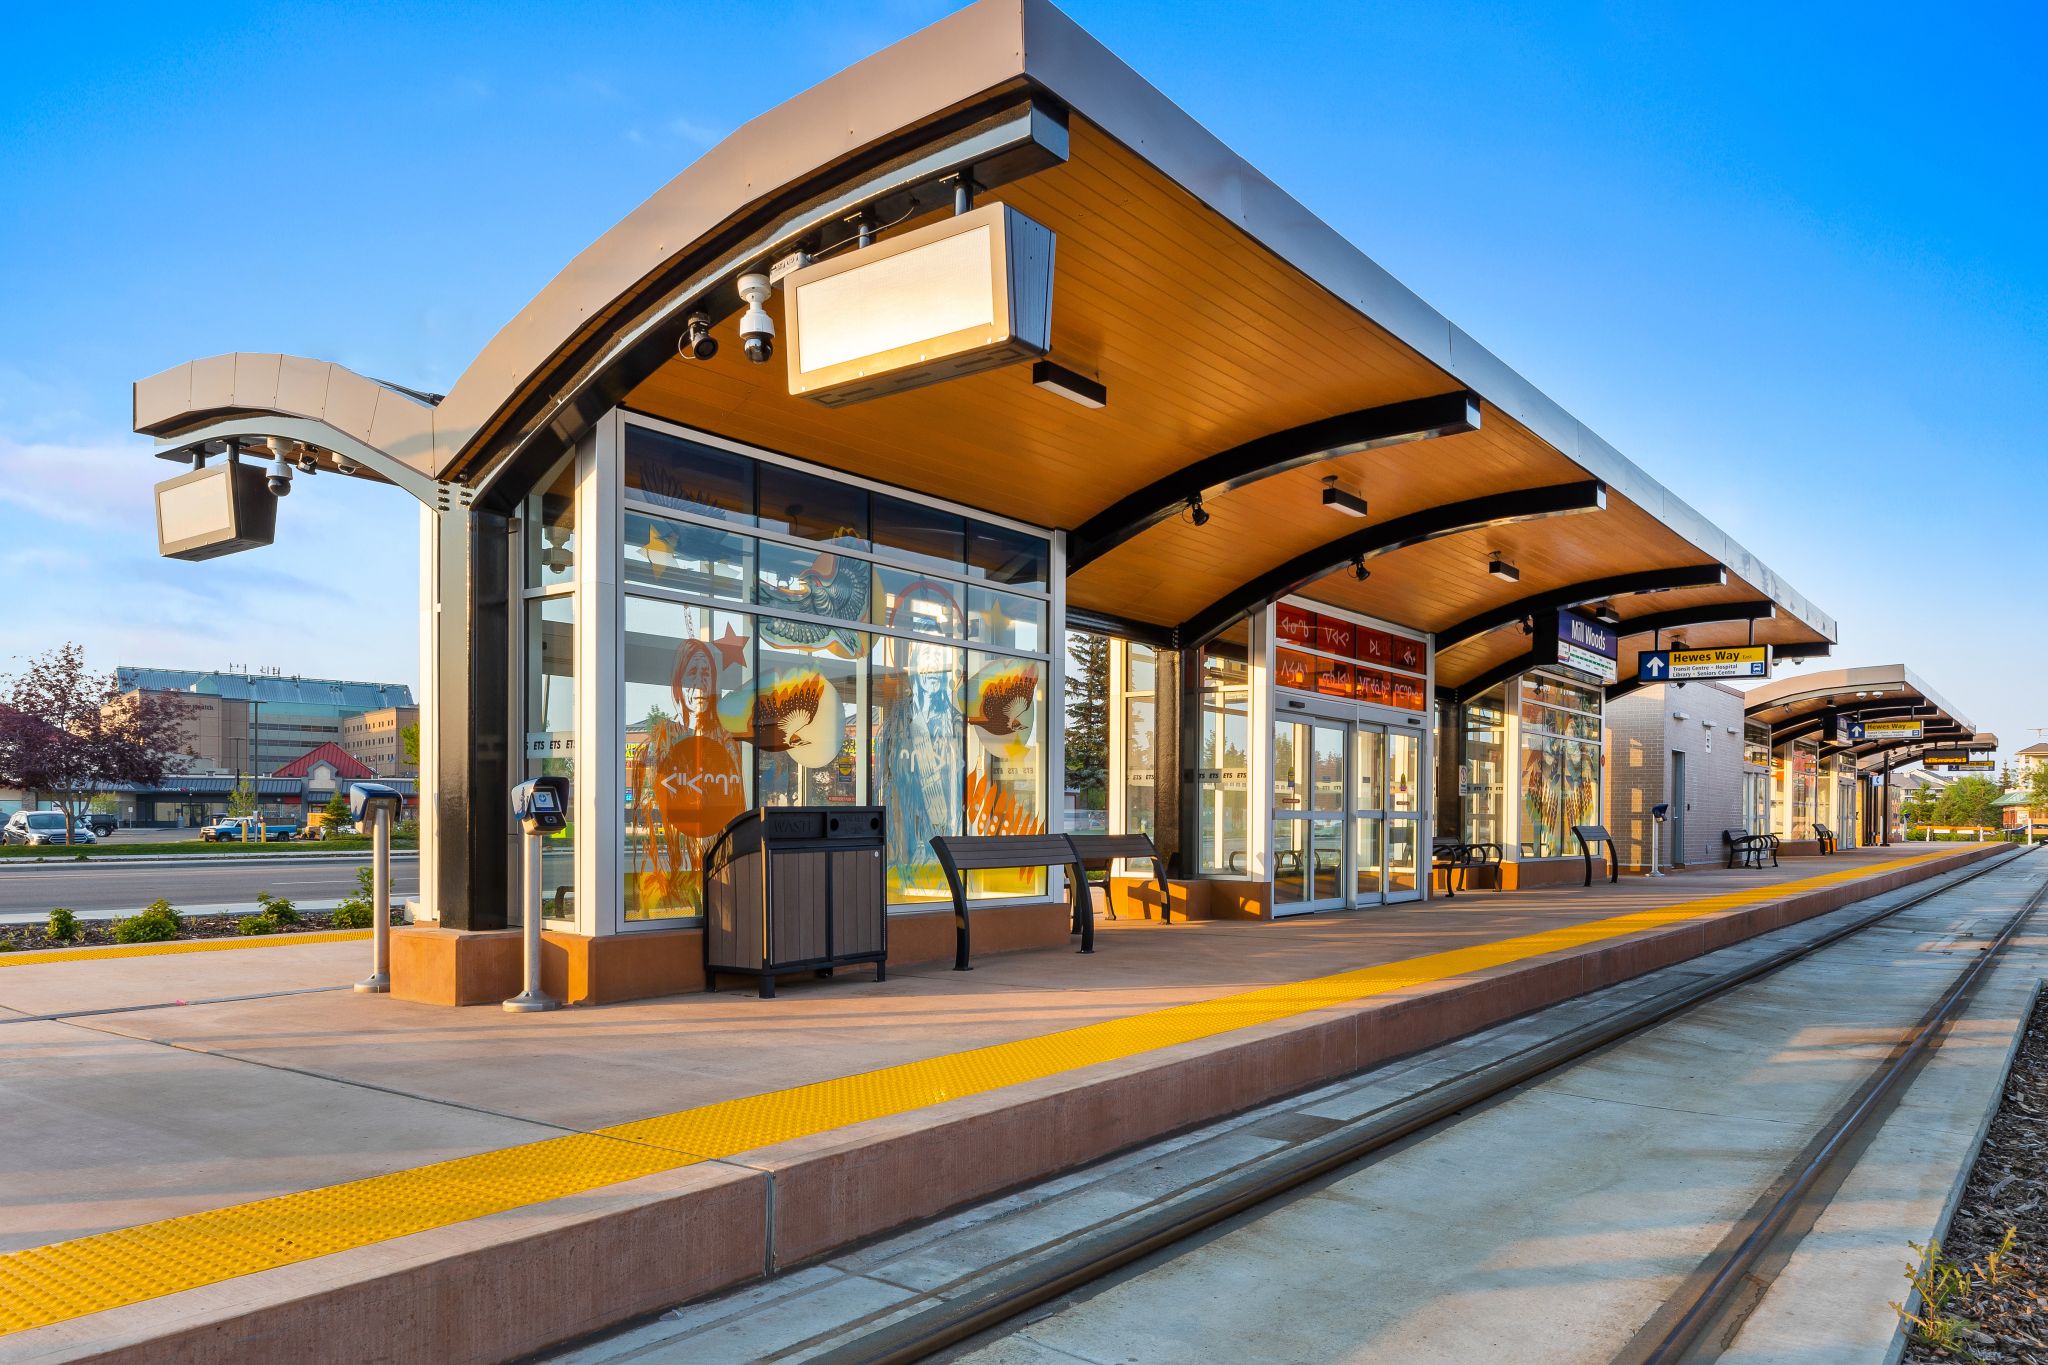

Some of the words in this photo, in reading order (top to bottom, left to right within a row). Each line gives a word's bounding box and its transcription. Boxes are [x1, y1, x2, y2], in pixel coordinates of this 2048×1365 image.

[1571, 619, 1585, 643] Mill
[1585, 625, 1606, 651] Woods
[1673, 652, 1711, 663] Hewes
[1715, 651, 1740, 661] Way
[533, 740, 545, 750] ETS
[549, 740, 561, 750] ETS
